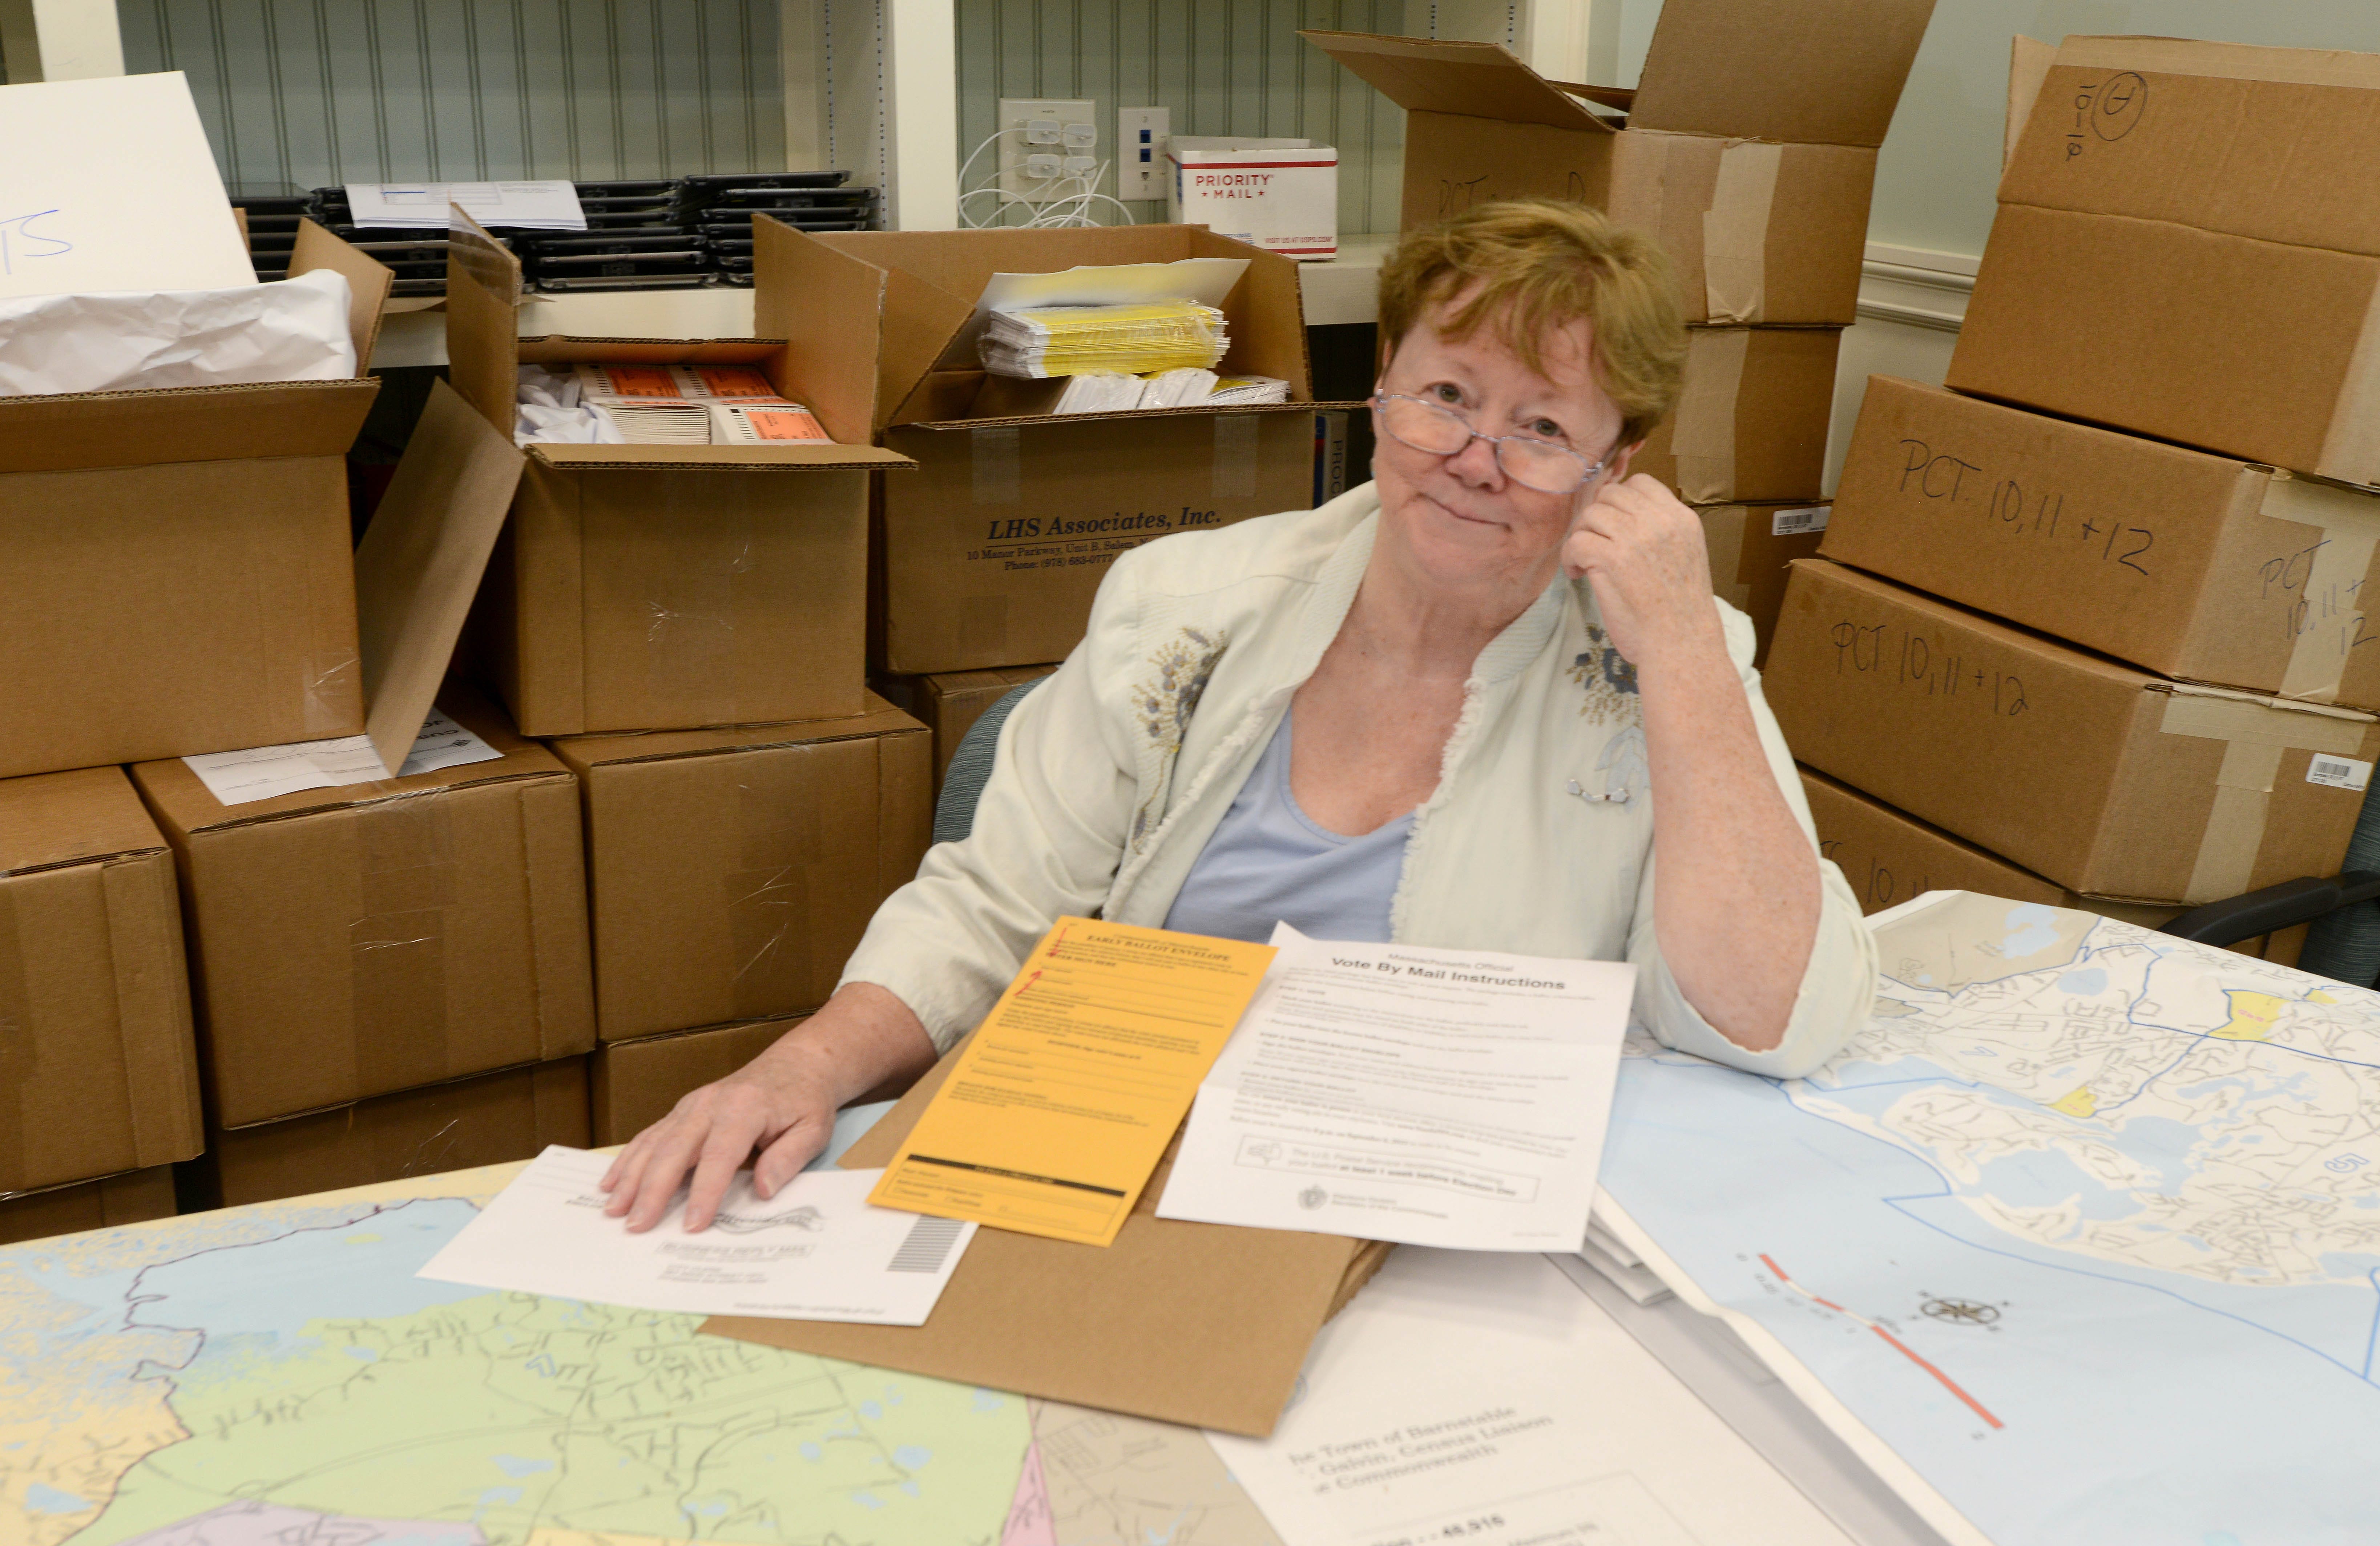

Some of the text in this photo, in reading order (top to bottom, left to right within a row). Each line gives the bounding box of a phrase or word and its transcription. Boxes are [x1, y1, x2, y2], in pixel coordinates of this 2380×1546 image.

[1195, 174, 1272, 186] PRIORITY
[1213, 189, 1252, 199] MAIL
[987, 507, 1222, 539] LHS Associates, Inc.
[967, 551, 979, 560] 10
[981, 547, 1014, 559] Manor
[2258, 539, 2332, 600] PCT
[2340, 617, 2378, 655] 12
[1867, 857, 1894, 903] 10
[1087, 935, 1231, 962] EARLY BALLOT ENVELOPE
[1331, 957, 1566, 991] Vote By Mail Instructions
[2325, 1152, 2371, 1174] 5
[1319, 1438, 1379, 1458] Town
[1383, 1430, 1403, 1445] of
[1406, 1407, 1516, 1438] Barnstable
